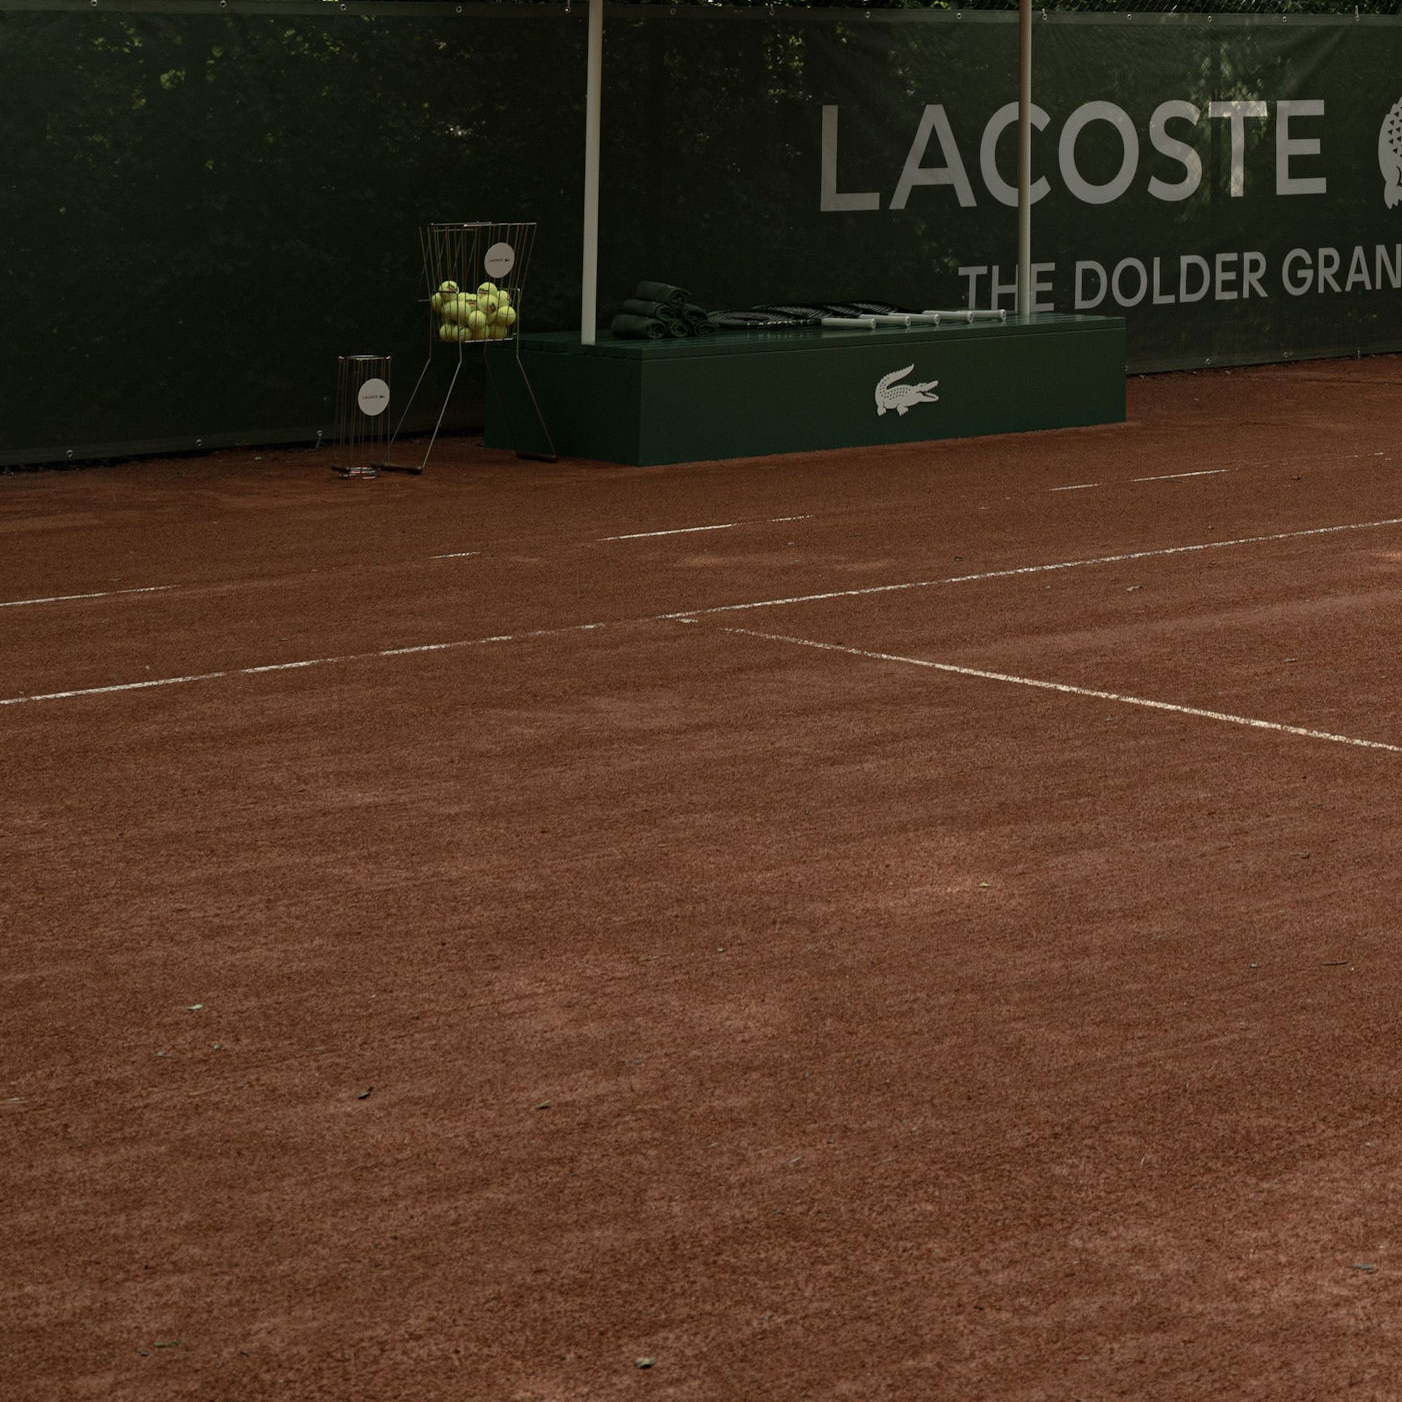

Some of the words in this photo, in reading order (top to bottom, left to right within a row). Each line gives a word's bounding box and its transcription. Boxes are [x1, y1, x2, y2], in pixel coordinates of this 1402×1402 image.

[820, 99, 1327, 212] LACOSTE
[958, 262, 1055, 313] THE
[1074, 251, 1268, 310] DOLDER
